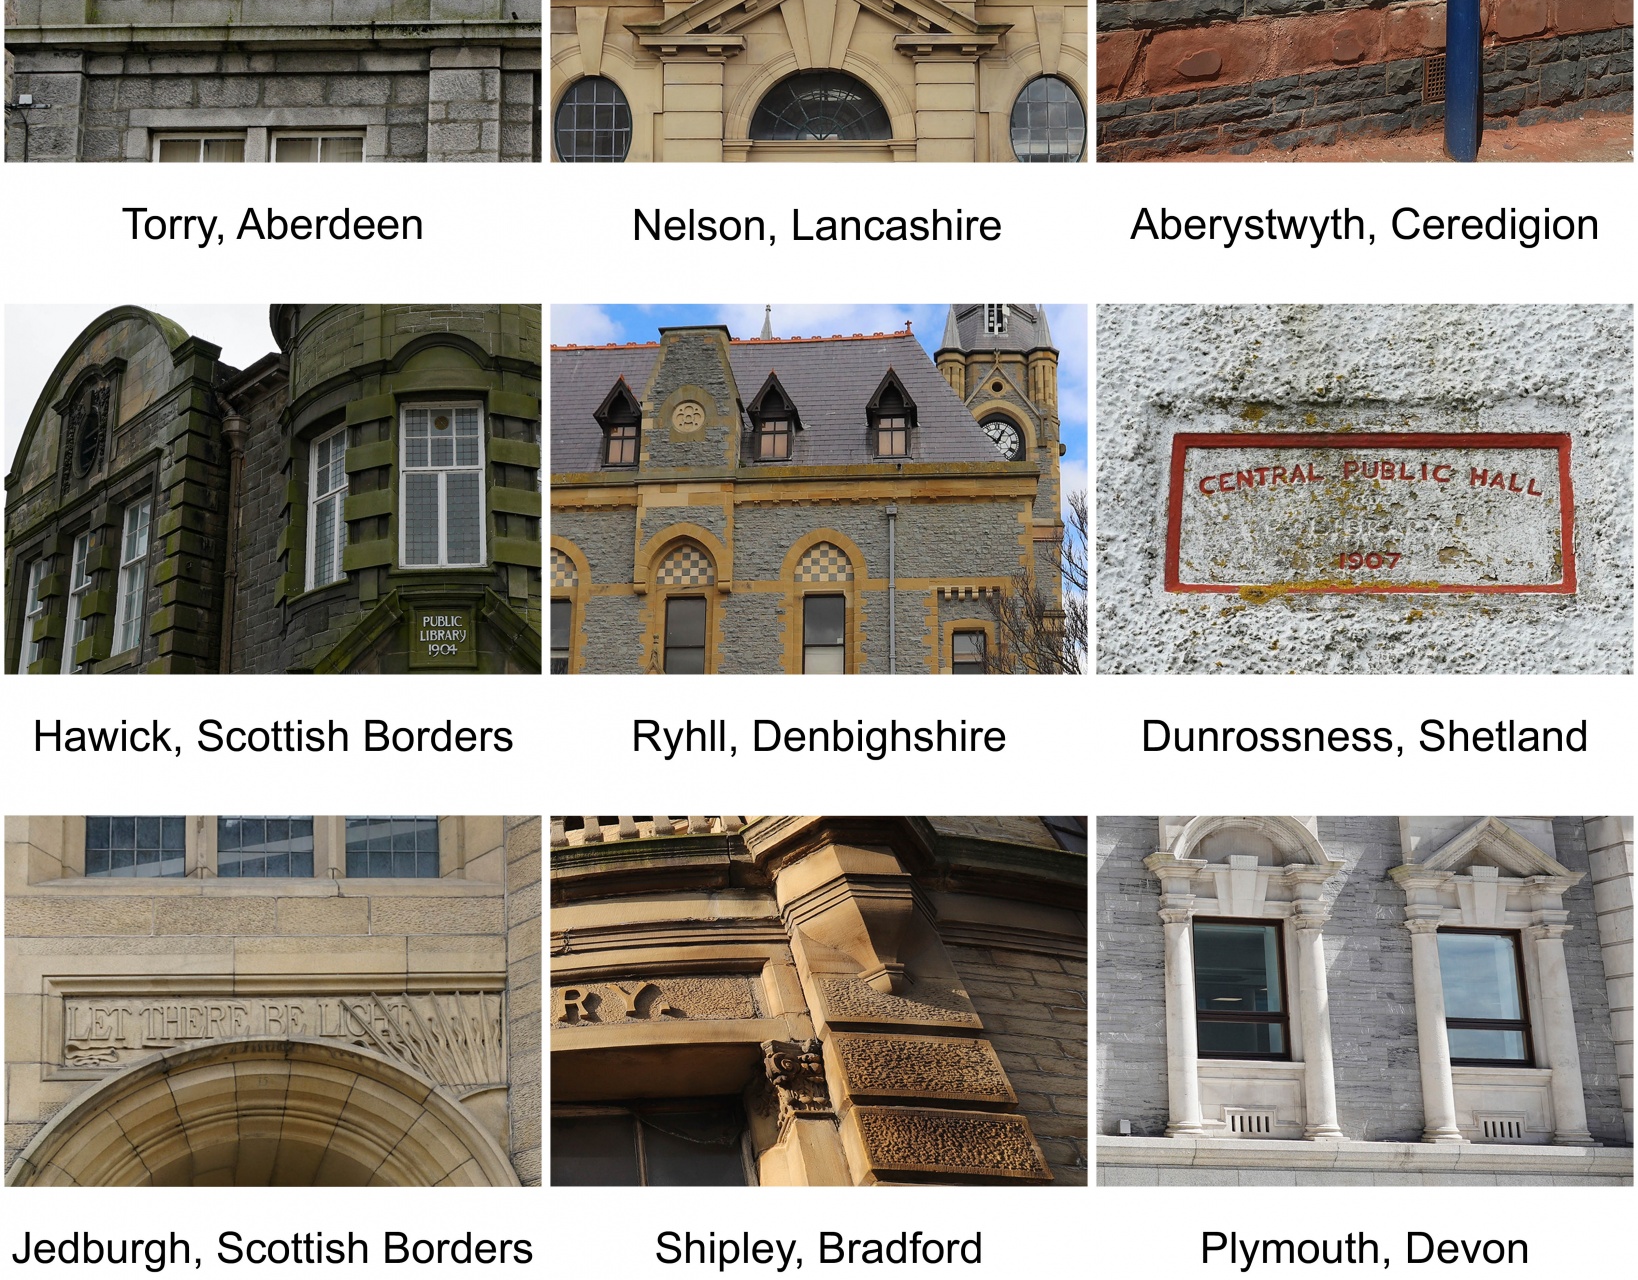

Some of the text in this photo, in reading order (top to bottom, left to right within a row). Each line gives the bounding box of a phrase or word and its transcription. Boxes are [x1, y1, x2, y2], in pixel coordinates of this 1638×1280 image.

[1199, 460, 1543, 497] CENTRAL PUBLIC HALL
[1339, 552, 1401, 570] 1907
[423, 616, 462, 627] PUBLIC
[420, 629, 467, 643] LIBRARY
[428, 644, 458, 657] 1904
[68, 1004, 412, 1040] LET THERE BE LIGHT
